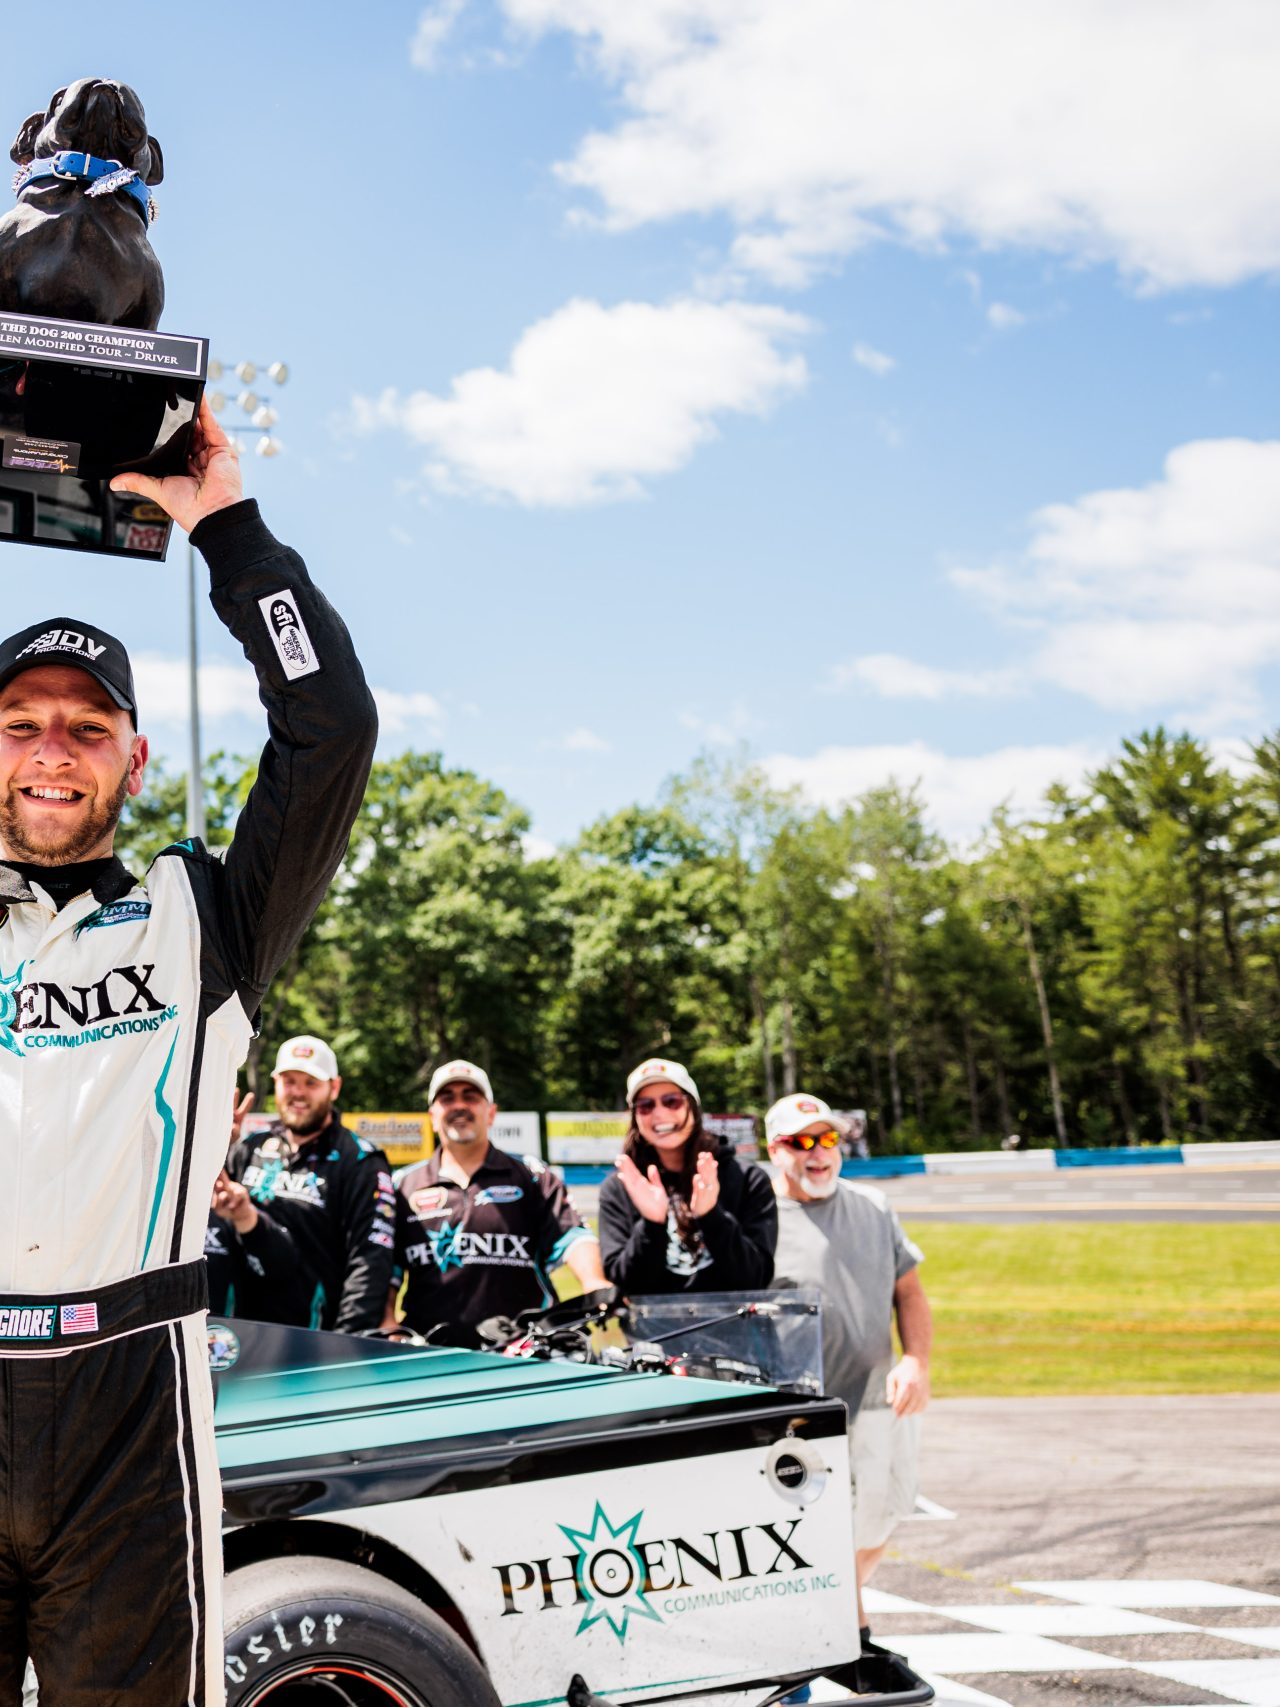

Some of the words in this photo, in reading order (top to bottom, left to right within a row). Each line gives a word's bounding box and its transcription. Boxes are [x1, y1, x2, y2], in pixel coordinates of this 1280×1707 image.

[0, 322, 28, 334] THE
[28, 325, 59, 338] DOG
[60, 330, 83, 341] 200
[84, 333, 155, 351] CHAMPION
[24, 336, 86, 352] MODIFIED
[88, 345, 123, 358] TOUR
[134, 351, 179, 365] DRIVER
[273, 604, 295, 627] sfi
[34, 645, 96, 661] PRODUCTIONS
[24, 1017, 160, 1049] COMMUNICATIONS
[406, 1232, 531, 1266] PHOENIX
[492, 1518, 814, 1617] PHOENIX
[663, 1577, 808, 1615] COMMUNICATIONS
[224, 1611, 344, 1690] osier
